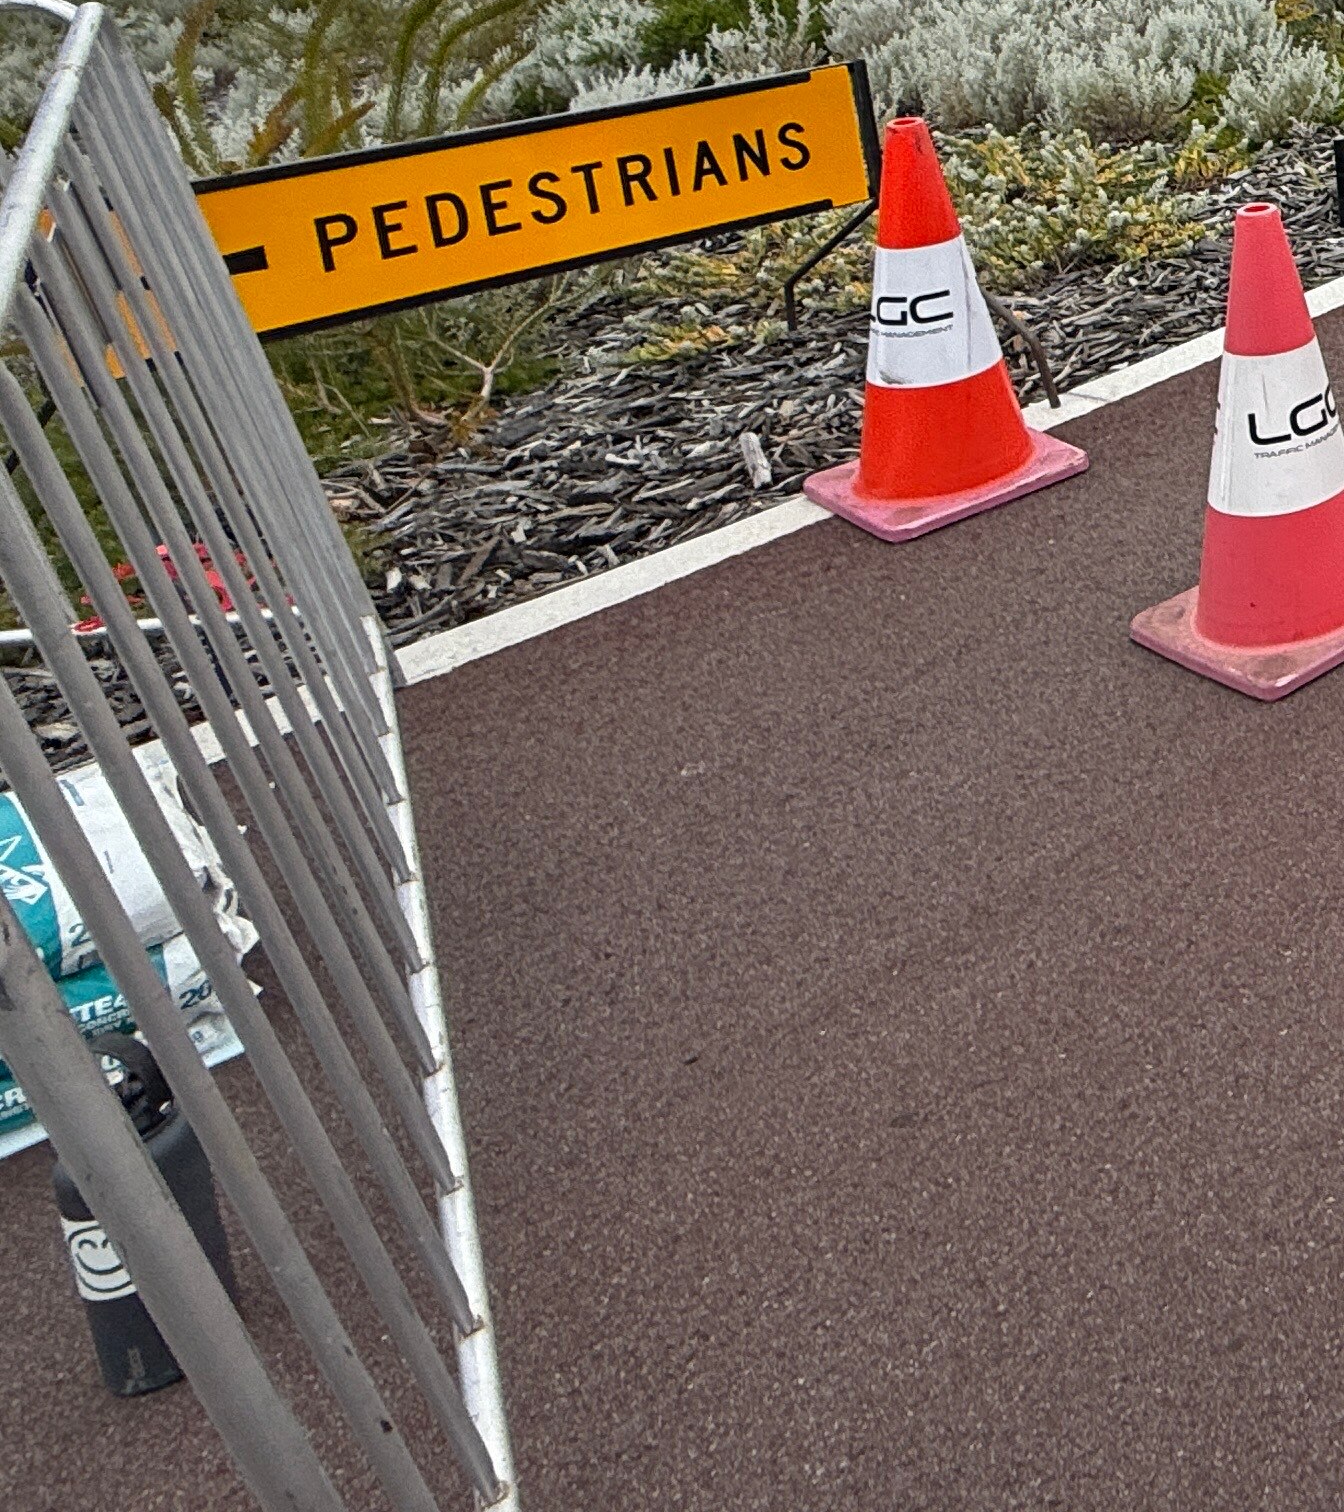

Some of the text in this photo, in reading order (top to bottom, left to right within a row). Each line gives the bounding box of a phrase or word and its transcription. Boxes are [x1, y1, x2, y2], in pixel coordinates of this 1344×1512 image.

[314, 122, 811, 273] PEDESTRIANS
[872, 289, 954, 326] GC
[1254, 444, 1304, 460] TRAFFIC
